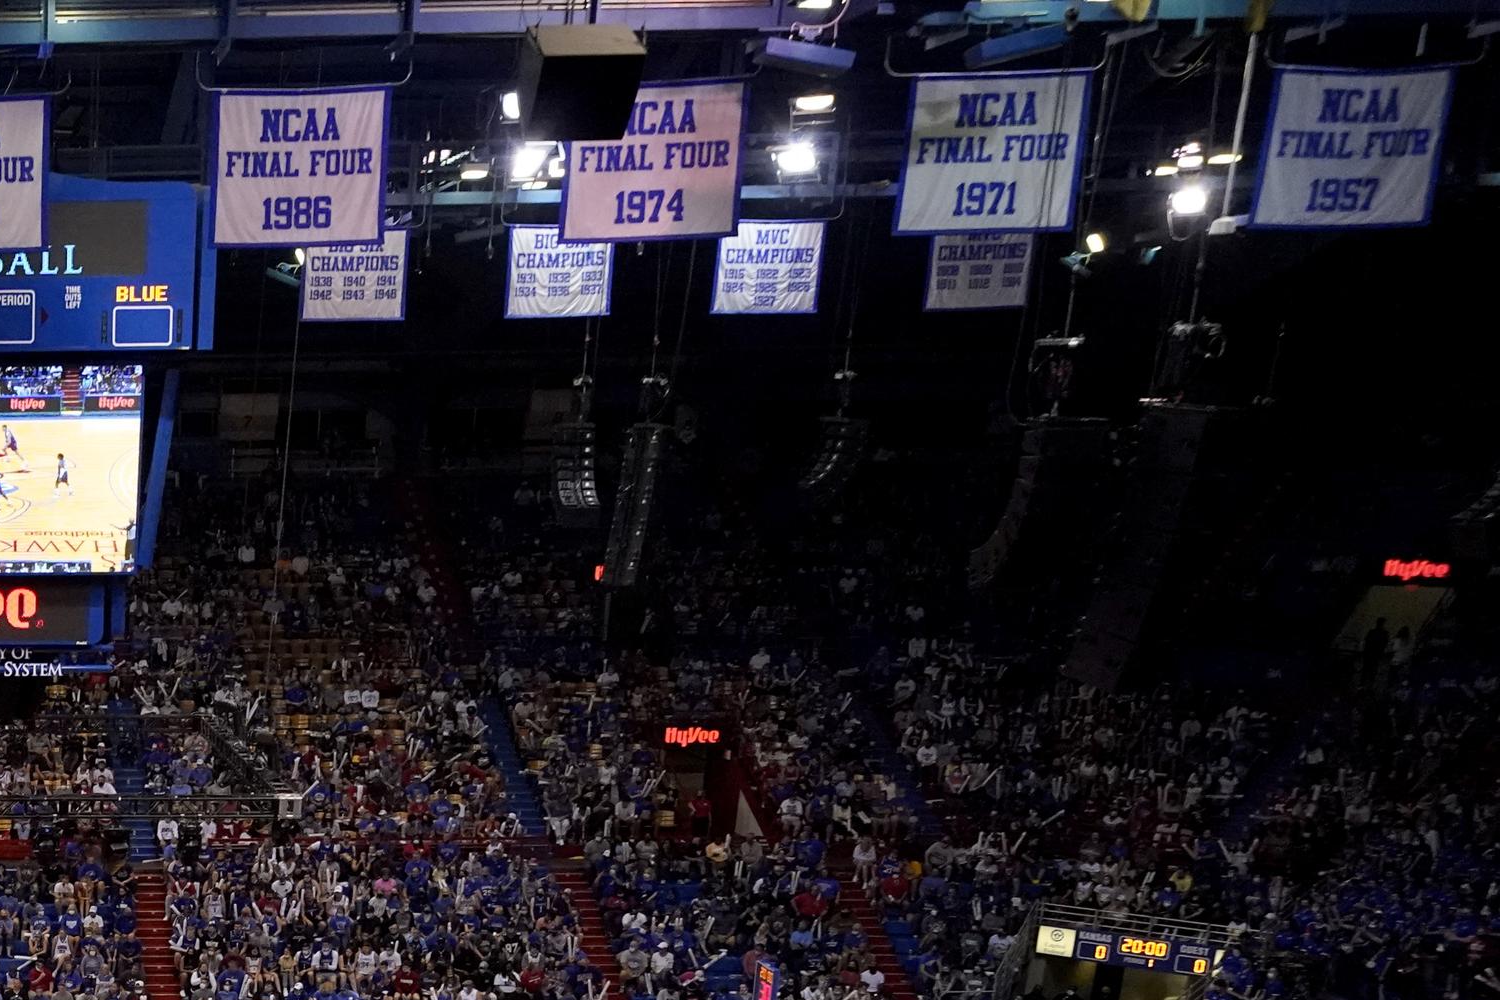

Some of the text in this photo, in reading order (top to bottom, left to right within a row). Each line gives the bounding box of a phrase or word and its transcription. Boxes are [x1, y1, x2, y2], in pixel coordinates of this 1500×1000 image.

[955, 92, 1038, 128] NCAA
[1318, 88, 1399, 124] NCAA
[261, 108, 341, 143] NCAA
[917, 133, 1069, 165] FINAL FOUR
[1277, 128, 1431, 159] FINAL FOUR
[226, 148, 373, 178] FINAL FOUR
[579, 140, 729, 173] FINAL FOUR
[952, 180, 1017, 217] 1971
[1305, 178, 1380, 213] 1957
[262, 195, 332, 231] 1986
[614, 189, 685, 225] 1974
[756, 229, 790, 244] MVC
[311, 255, 399, 272] CHAMPIONS
[516, 251, 605, 268] CHAMPIONS
[726, 248, 814, 264] CHAMPIONS
[343, 276, 366, 287] 1940
[377, 275, 396, 286] 1941
[116, 285, 168, 302] BLUE
[309, 289, 365, 300] 1942 1943
[1384, 559, 1450, 580] HyVee
[11, 647, 33, 660] OF
[3, 661, 63, 677] SYSTEM
[665, 727, 720, 748] HyVee
[1094, 945, 1107, 960] 0
[1121, 938, 1167, 957] 20:00
[1193, 959, 1206, 974] 0
